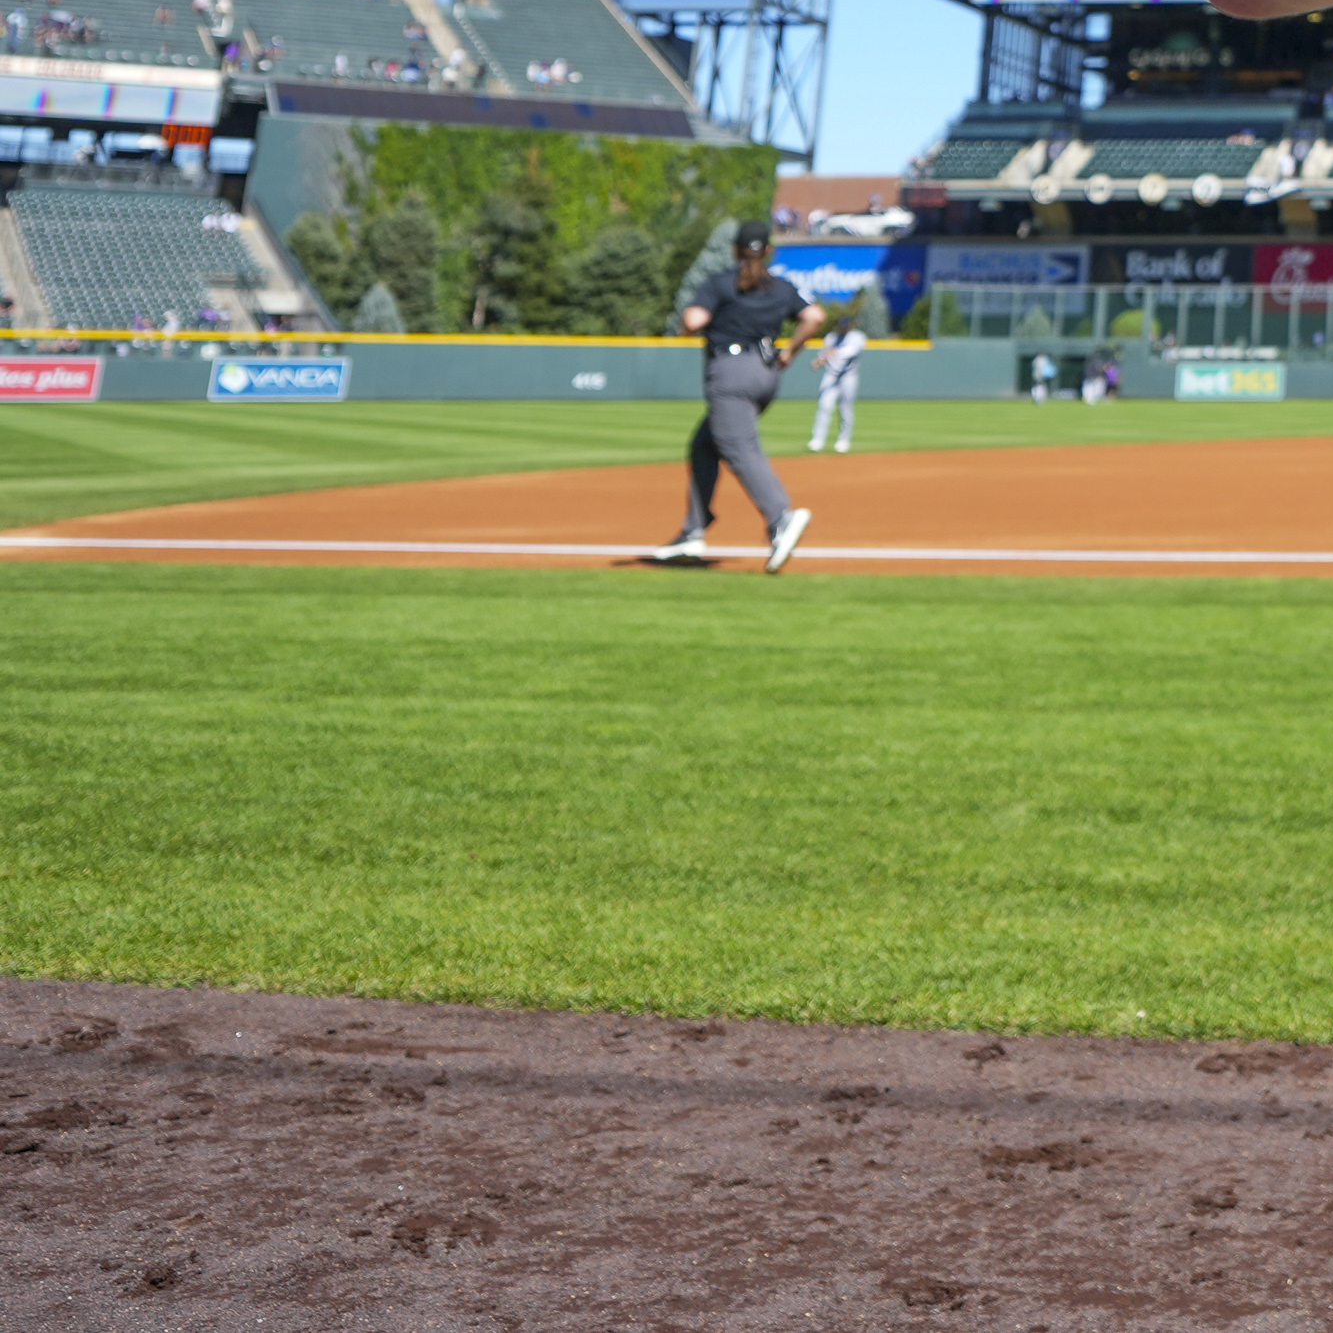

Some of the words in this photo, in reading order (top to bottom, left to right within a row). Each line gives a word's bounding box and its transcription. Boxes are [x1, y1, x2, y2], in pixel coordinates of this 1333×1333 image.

[1125, 249, 1192, 280] Bank
[1195, 247, 1229, 279] of
[36, 366, 89, 393] plus
[1180, 368, 1277, 394] bet365
